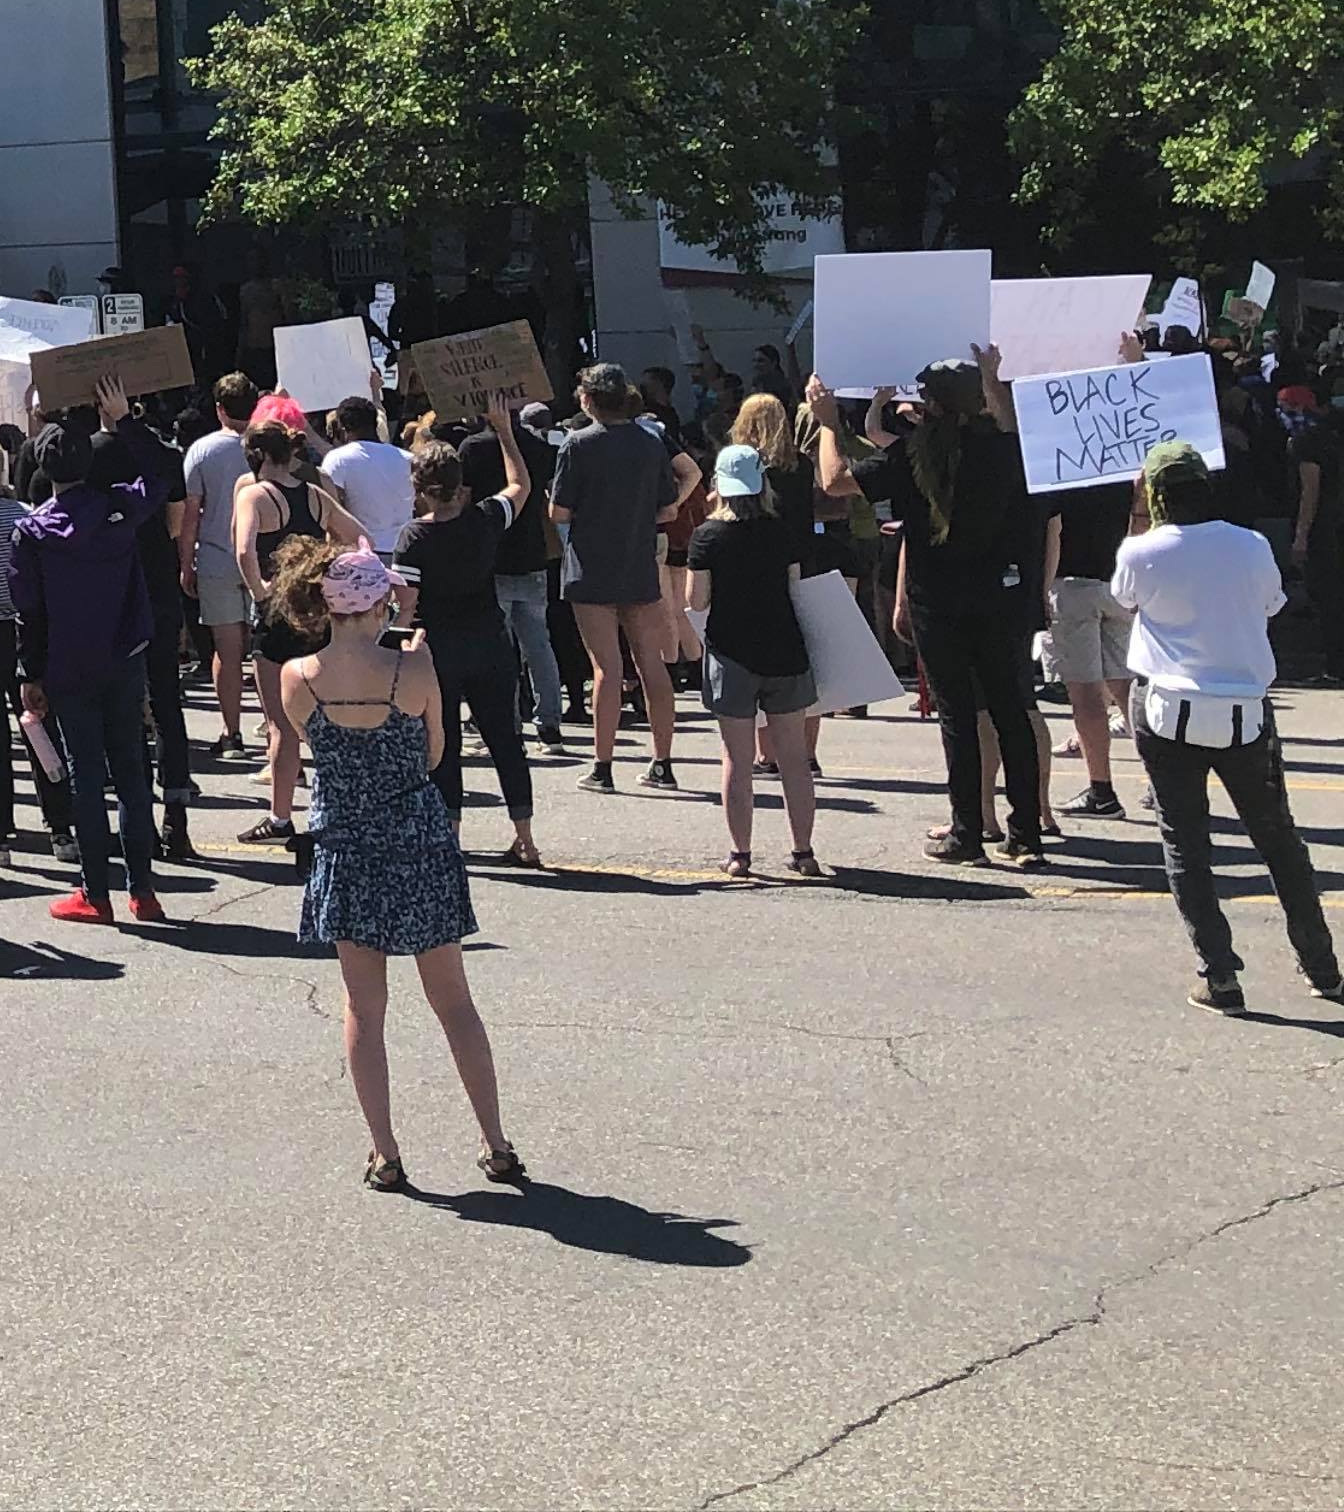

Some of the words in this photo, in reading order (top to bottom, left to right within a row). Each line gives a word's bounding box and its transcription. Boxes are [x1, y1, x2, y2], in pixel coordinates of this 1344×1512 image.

[105, 298, 115, 313] 2
[121, 316, 138, 325] AM
[1045, 366, 1160, 416] BLACK
[1072, 402, 1161, 445] LIVES
